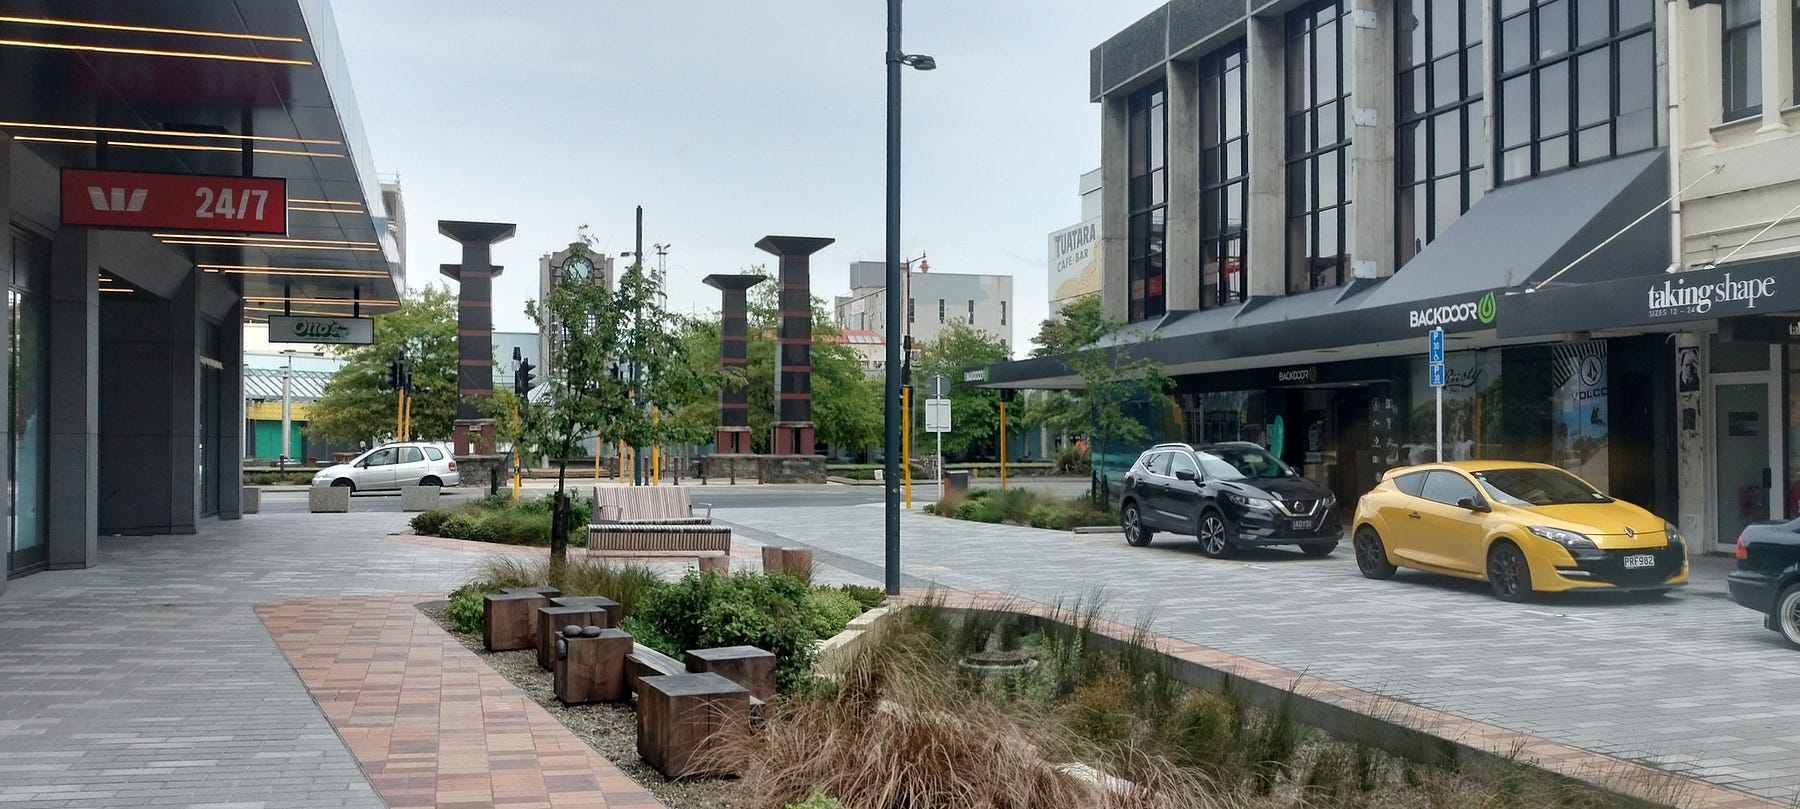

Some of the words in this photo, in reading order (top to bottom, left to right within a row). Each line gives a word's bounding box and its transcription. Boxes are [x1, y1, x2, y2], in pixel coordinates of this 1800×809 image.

[195, 187, 268, 220] 24/7
[1054, 223, 1096, 258] TUATARA
[1648, 278, 1713, 314] taking
[1715, 272, 1776, 309] shape
[1410, 302, 1477, 328] BACKDOOR
[1648, 308, 1667, 318] SIZES
[1686, 306, 1696, 314] 24
[1433, 332, 1439, 341] P
[1434, 365, 1440, 373] P
[1279, 370, 1309, 381] BACKDOOR
[1624, 556, 1654, 567] PRF982
